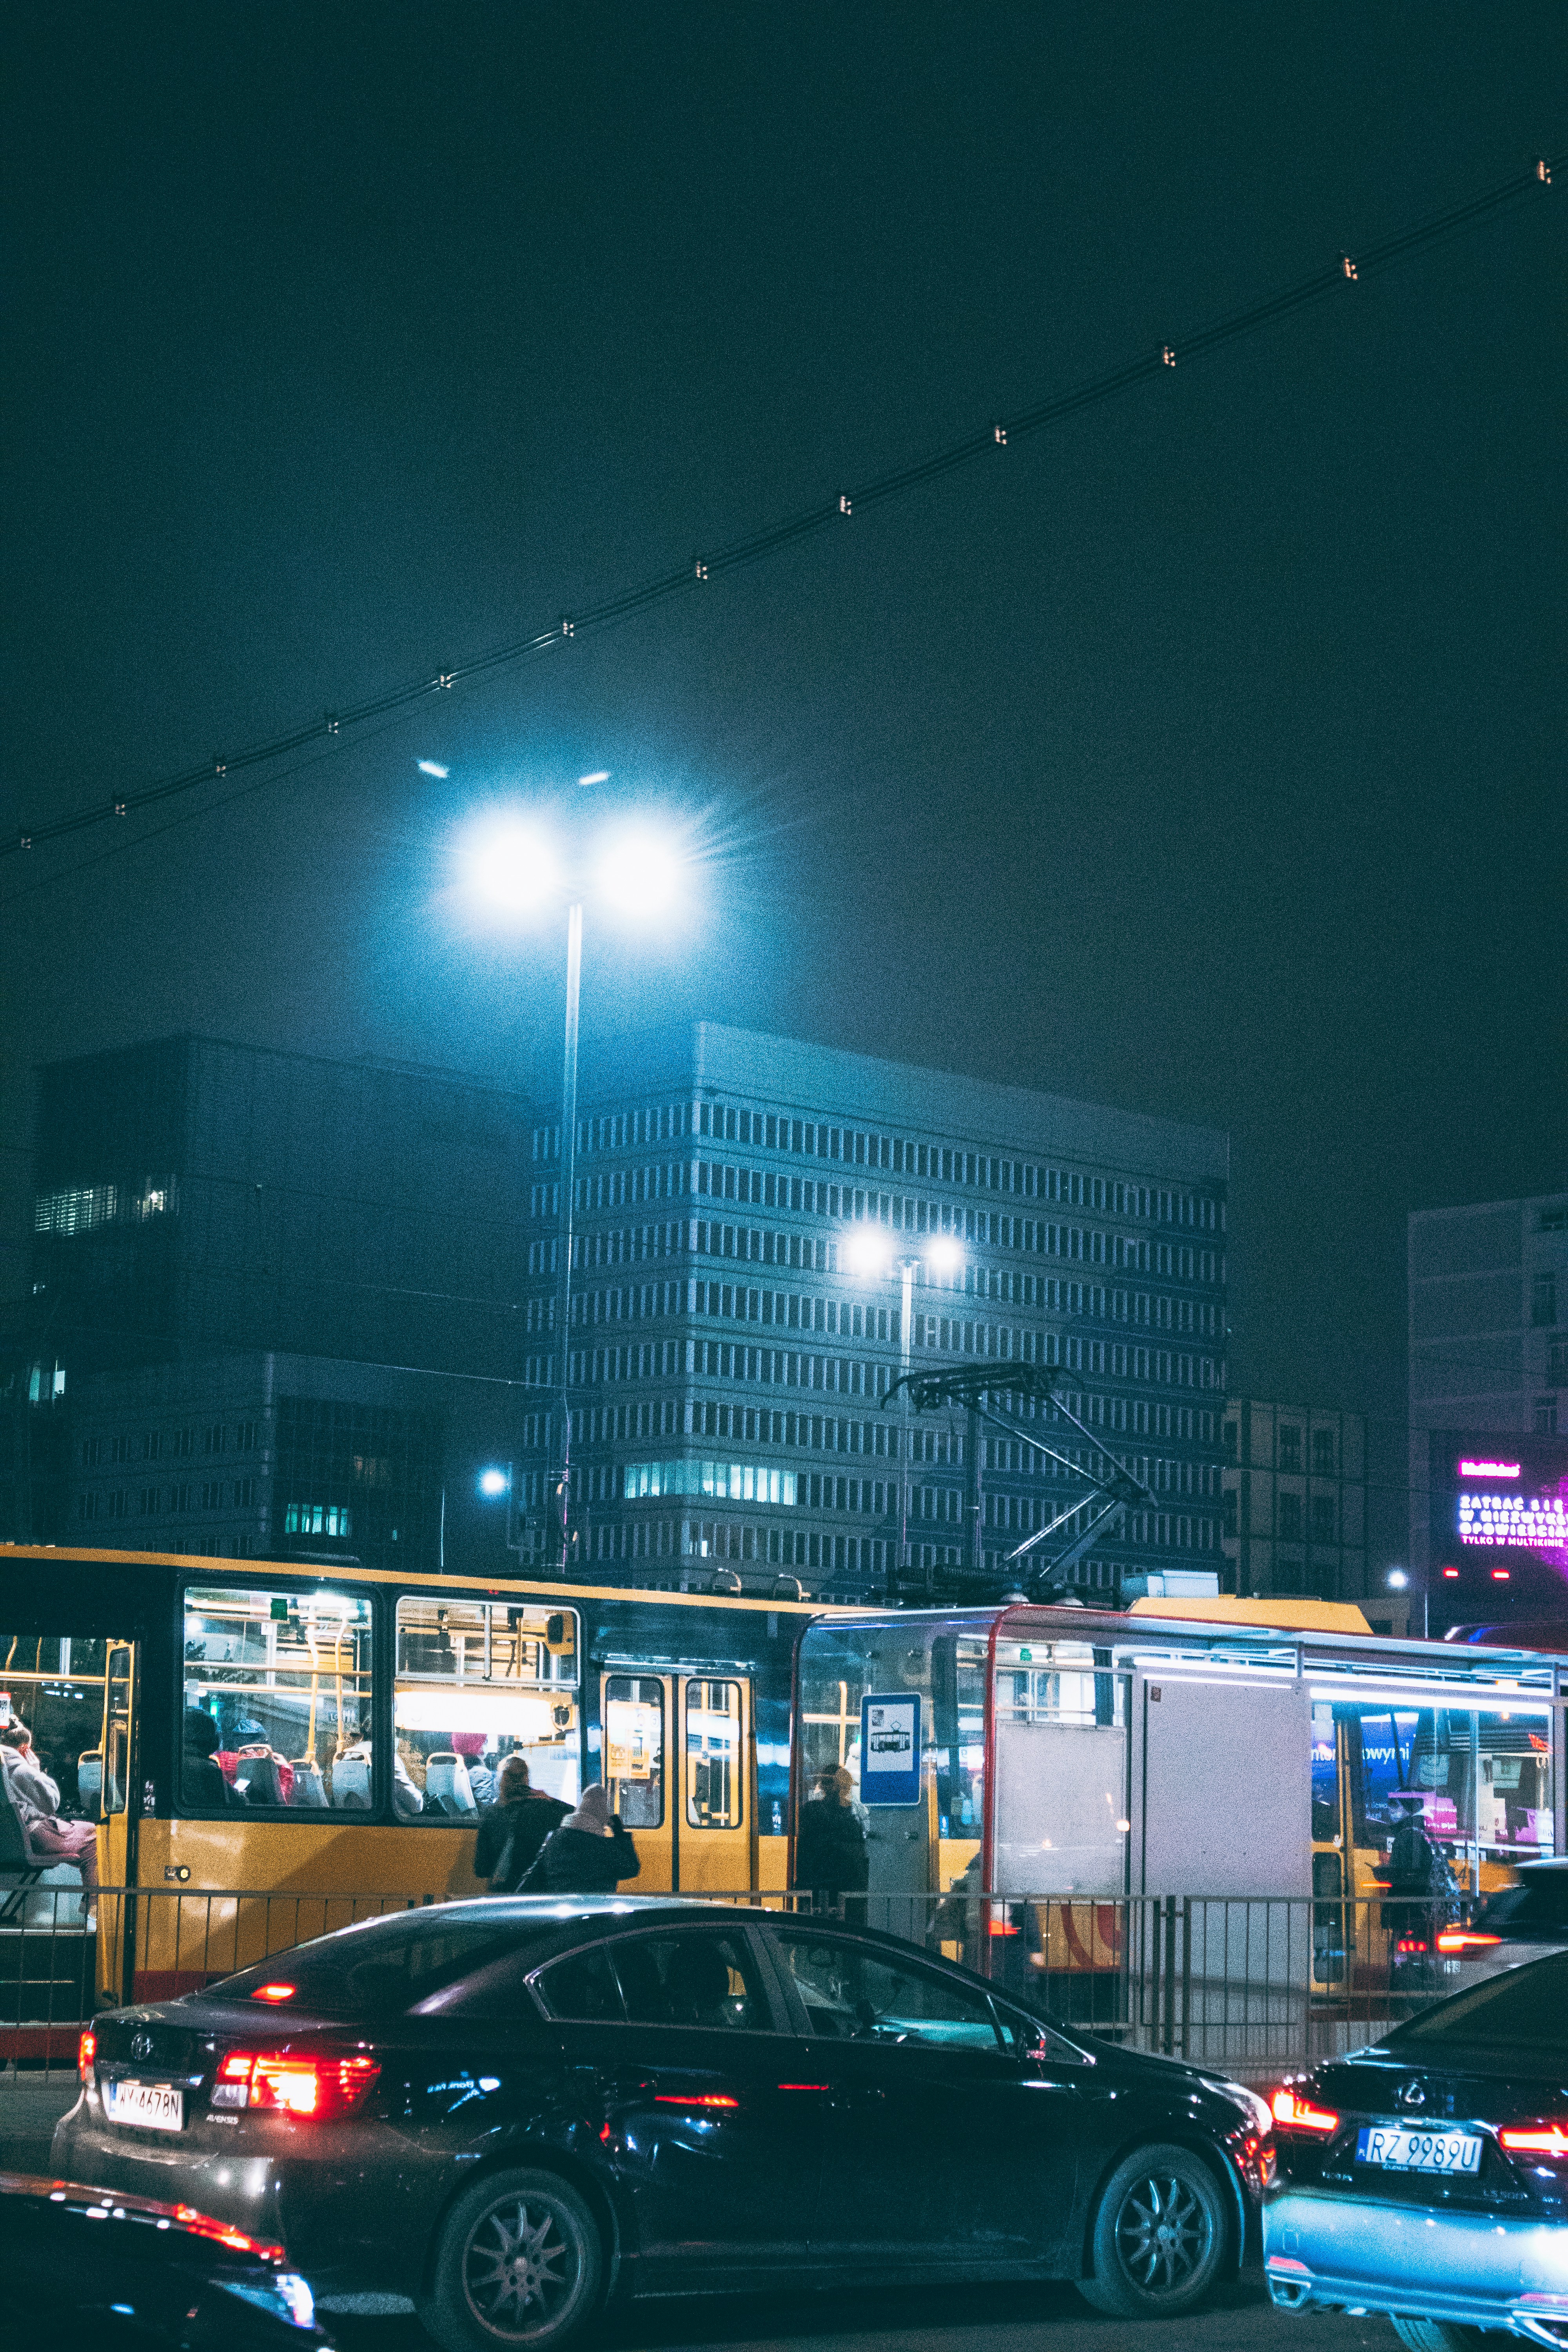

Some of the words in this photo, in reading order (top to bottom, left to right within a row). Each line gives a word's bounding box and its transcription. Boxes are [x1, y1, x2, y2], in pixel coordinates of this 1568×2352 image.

[1459, 1510, 1474, 1522] W
[1480, 1510, 1568, 1525] NIEZWYKŁ
[1459, 1521, 1568, 1538] OPOWIEŚCIA
[1462, 1535, 1494, 1545] TYLKO
[1495, 1537, 1506, 1546] W
[1508, 1537, 1564, 1547] MULTIKINIE
[139, 2091, 179, 2119] 4678N
[1370, 2132, 1400, 2162] RZ
[1408, 2136, 1477, 2169] 9989U
